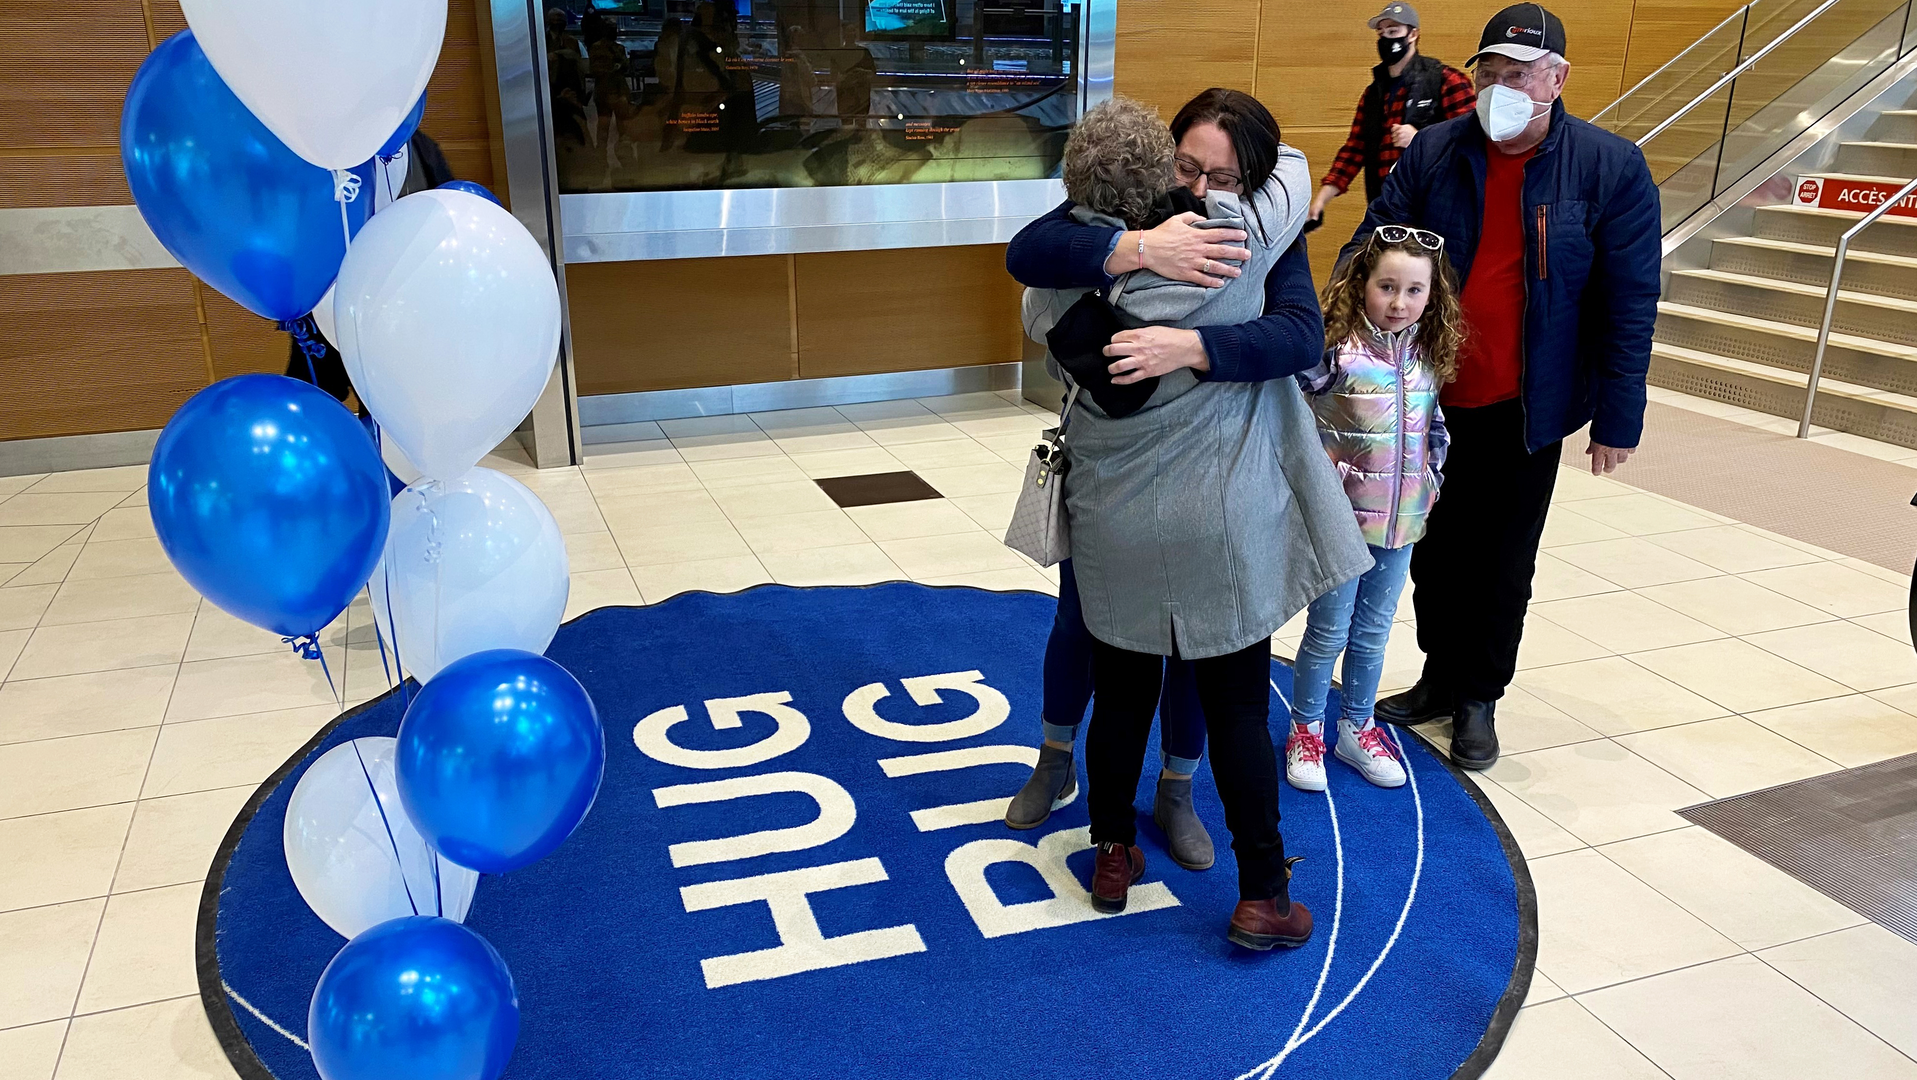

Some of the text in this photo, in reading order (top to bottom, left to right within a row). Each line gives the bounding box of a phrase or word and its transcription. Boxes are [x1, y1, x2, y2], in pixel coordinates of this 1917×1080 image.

[1838, 187, 1887, 205] ACCÈS
[633, 690, 928, 990] HUG
[842, 669, 1184, 939] RUG
